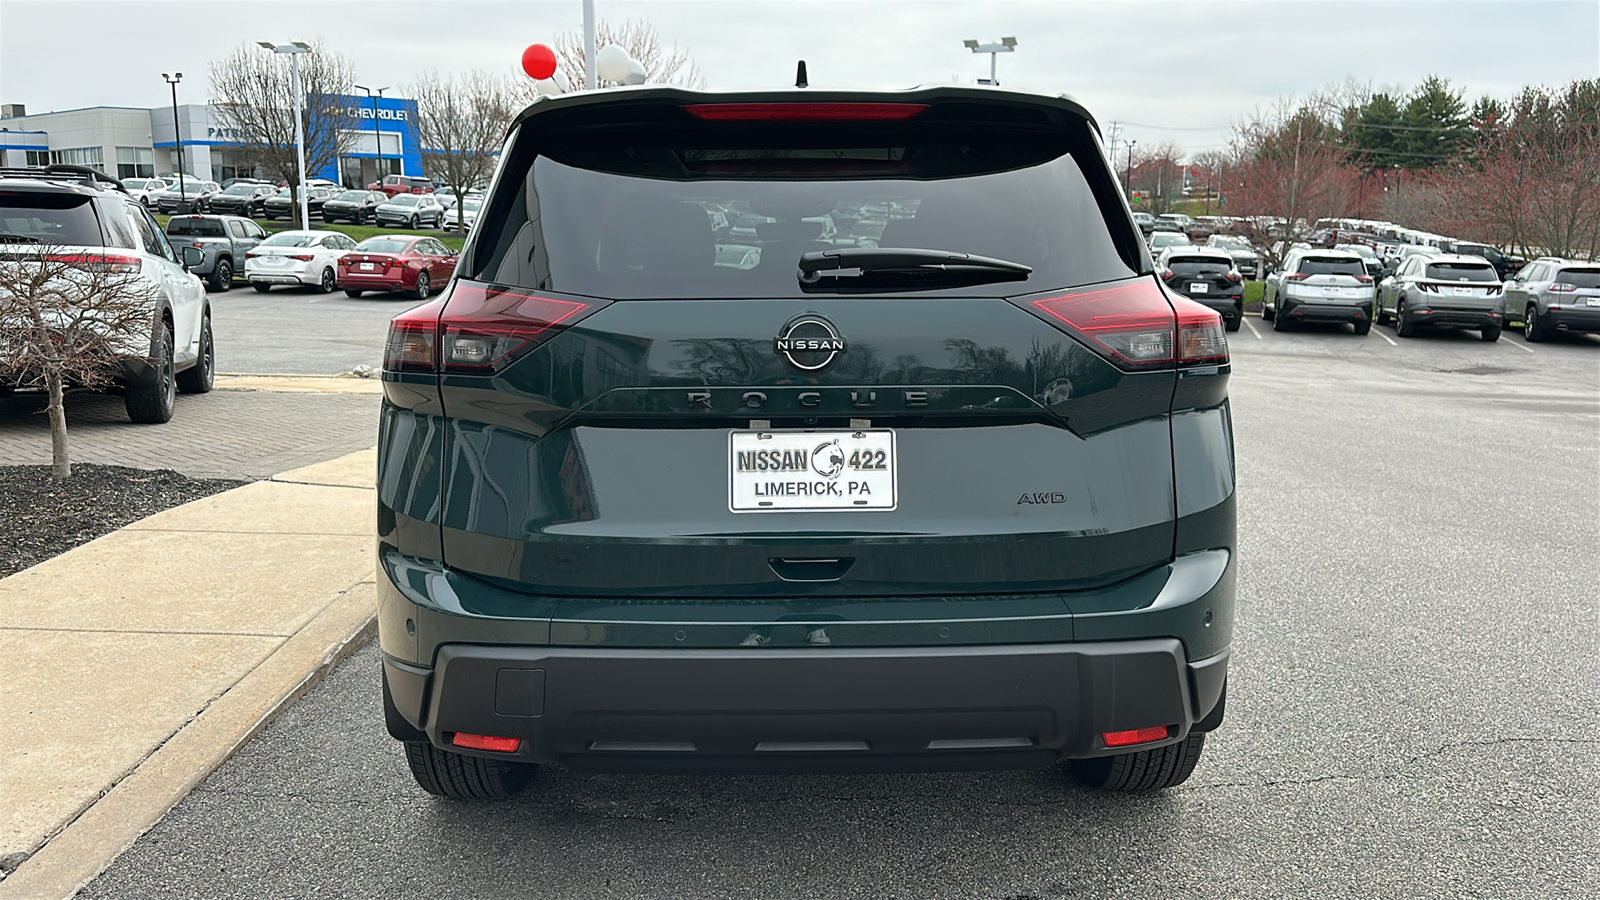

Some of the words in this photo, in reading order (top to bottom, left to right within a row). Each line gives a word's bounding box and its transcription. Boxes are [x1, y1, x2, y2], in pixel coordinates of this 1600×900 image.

[346, 107, 408, 121] CHEVROLET
[777, 340, 843, 350] NISSAN
[687, 391, 928, 409] ROGUE
[737, 450, 808, 472] NISSAN
[848, 450, 888, 471] 422
[755, 482, 843, 497] LIMERICK,
[848, 481, 871, 495] PA
[1017, 492, 1067, 505] AWD
